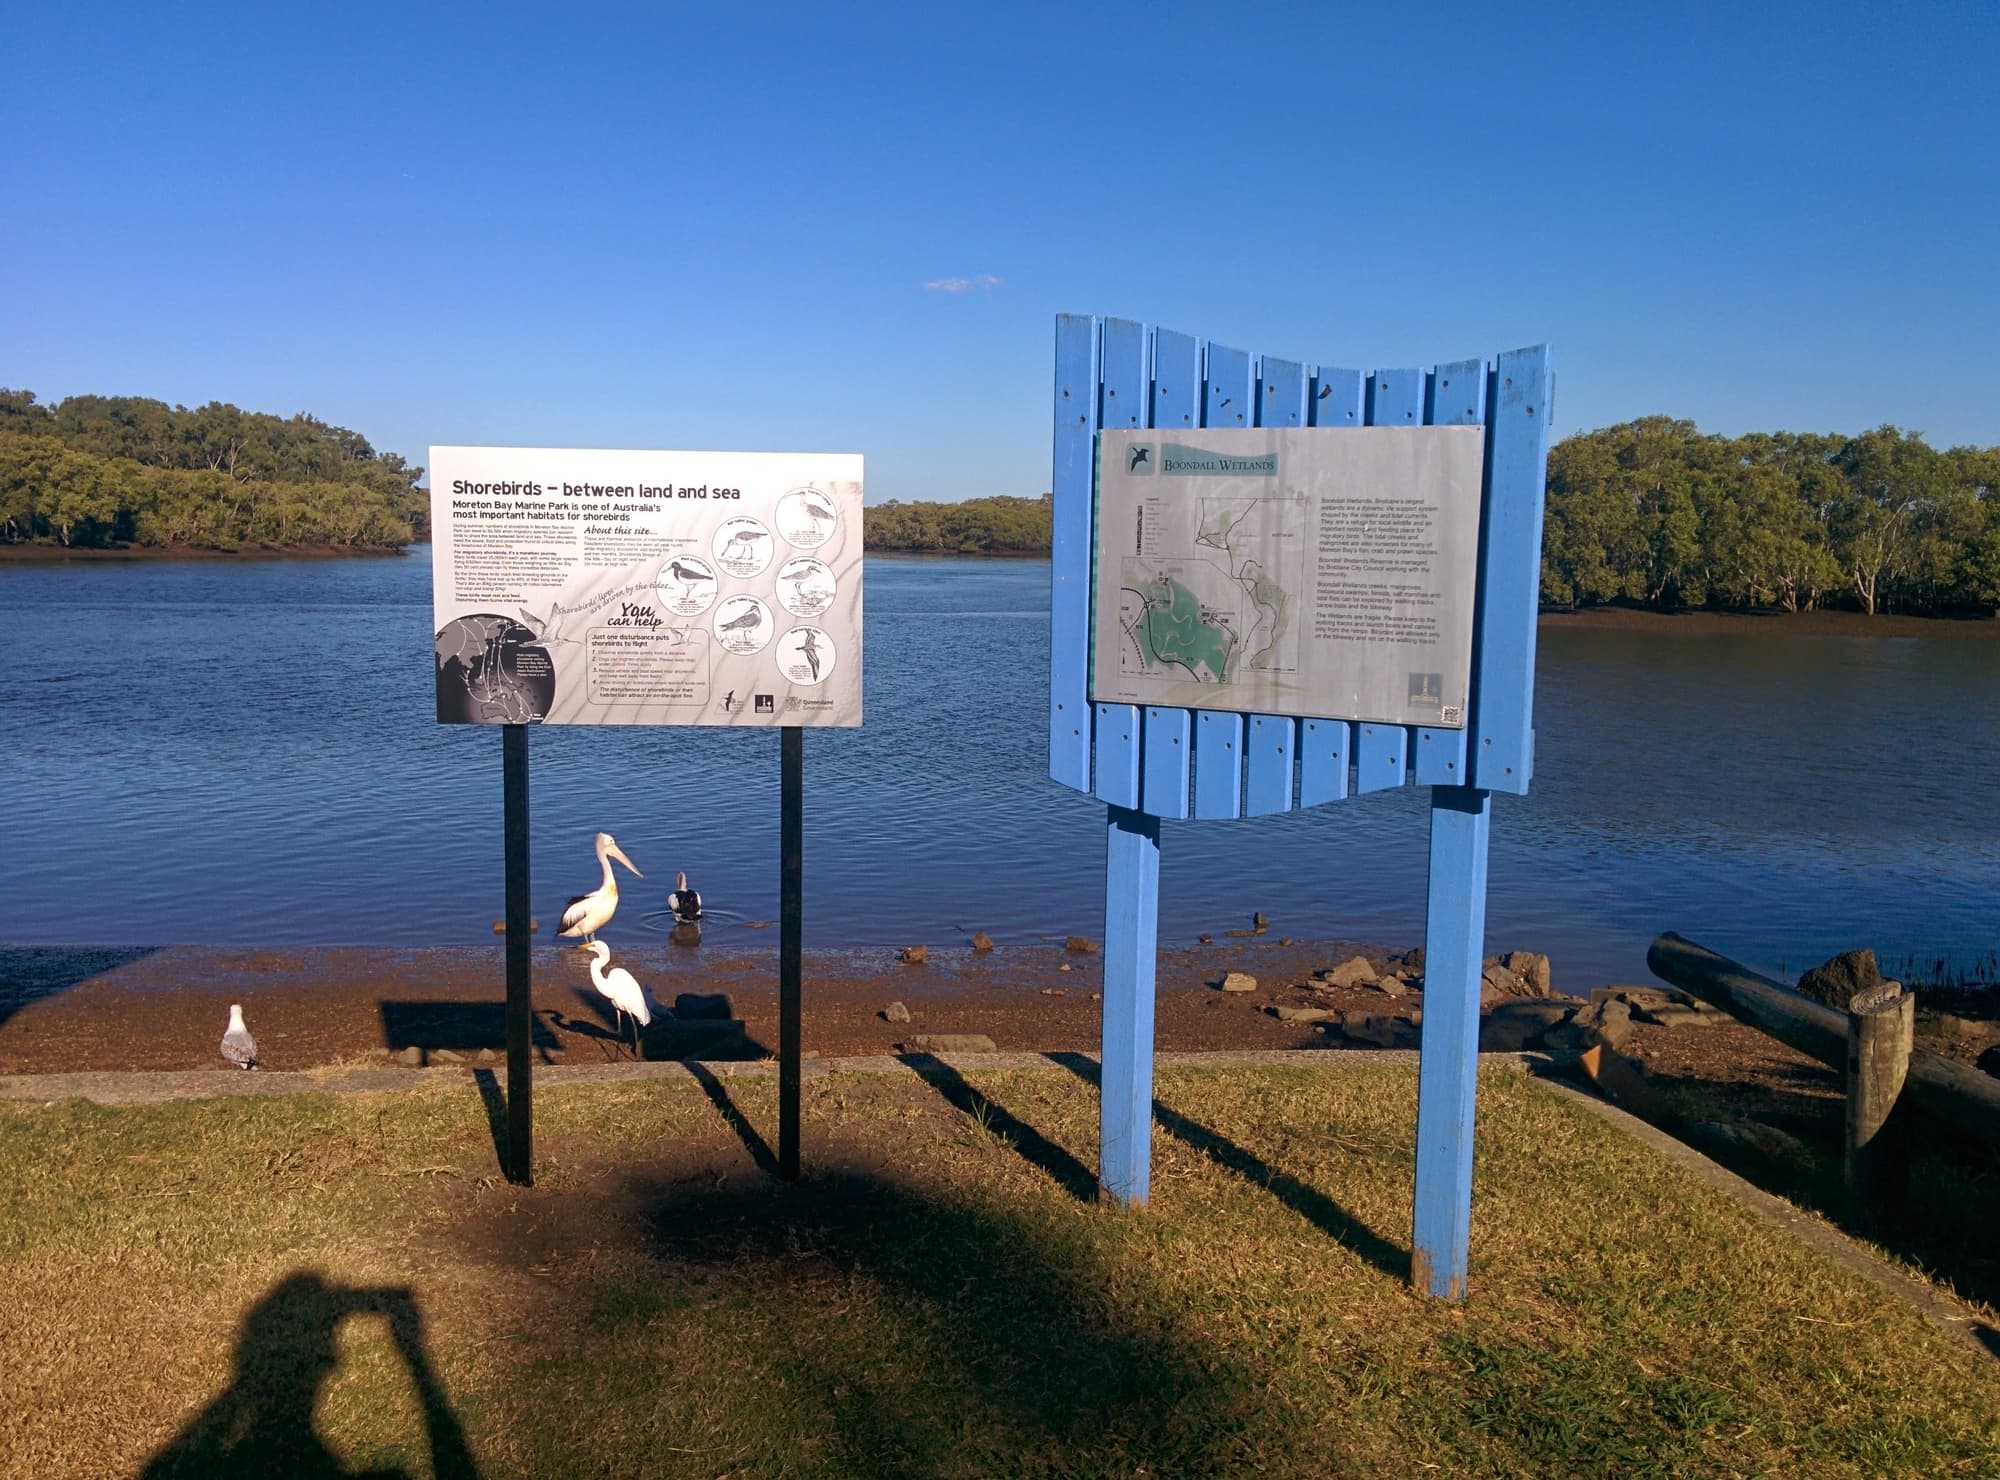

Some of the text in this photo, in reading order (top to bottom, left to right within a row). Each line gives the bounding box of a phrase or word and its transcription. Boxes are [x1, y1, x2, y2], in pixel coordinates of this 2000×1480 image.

[453, 480, 542, 495] Shorebirds
[563, 482, 634, 497] between
[639, 484, 672, 498] land
[678, 485, 707, 499] and
[712, 488, 740, 499] sea
[453, 500, 492, 509] Moreton
[494, 501, 512, 511] Bay
[515, 502, 546, 510] Marine
[549, 502, 569, 510] Park
[601, 503, 610, 511] of
[613, 503, 661, 512] Australia's
[453, 511, 630, 521] most important habitats for shorebirds
[584, 525, 612, 535] About
[614, 525, 632, 535] this
[621, 602, 656, 617] You
[607, 615, 664, 632] can help
